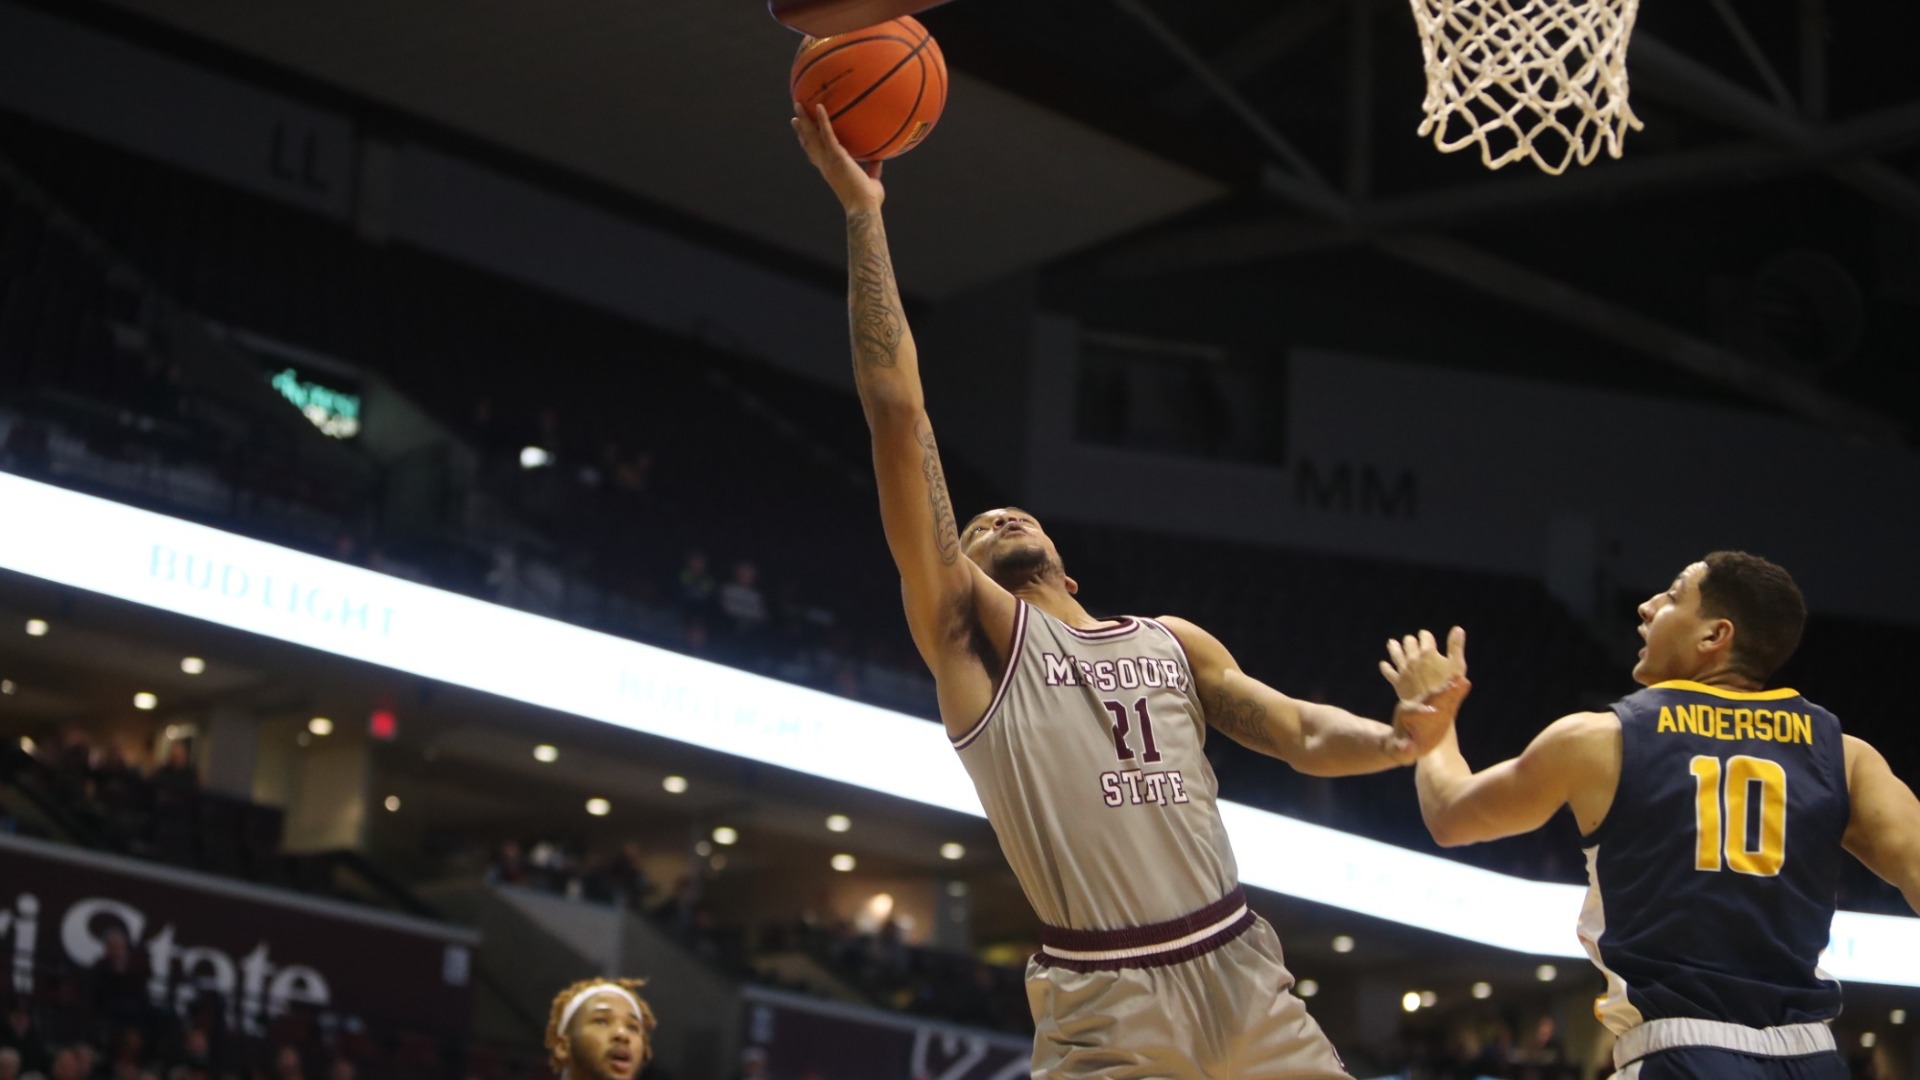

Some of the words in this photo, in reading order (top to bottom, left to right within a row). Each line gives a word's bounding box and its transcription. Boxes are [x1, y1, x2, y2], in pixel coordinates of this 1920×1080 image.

[270, 121, 330, 190] LL
[1295, 456, 1417, 520] MM
[149, 542, 251, 600] BUD
[261, 574, 398, 638] LIGHT
[1102, 695, 1162, 763] 21
[1657, 704, 1813, 745] ANDERSON
[1689, 754, 1787, 877] 10
